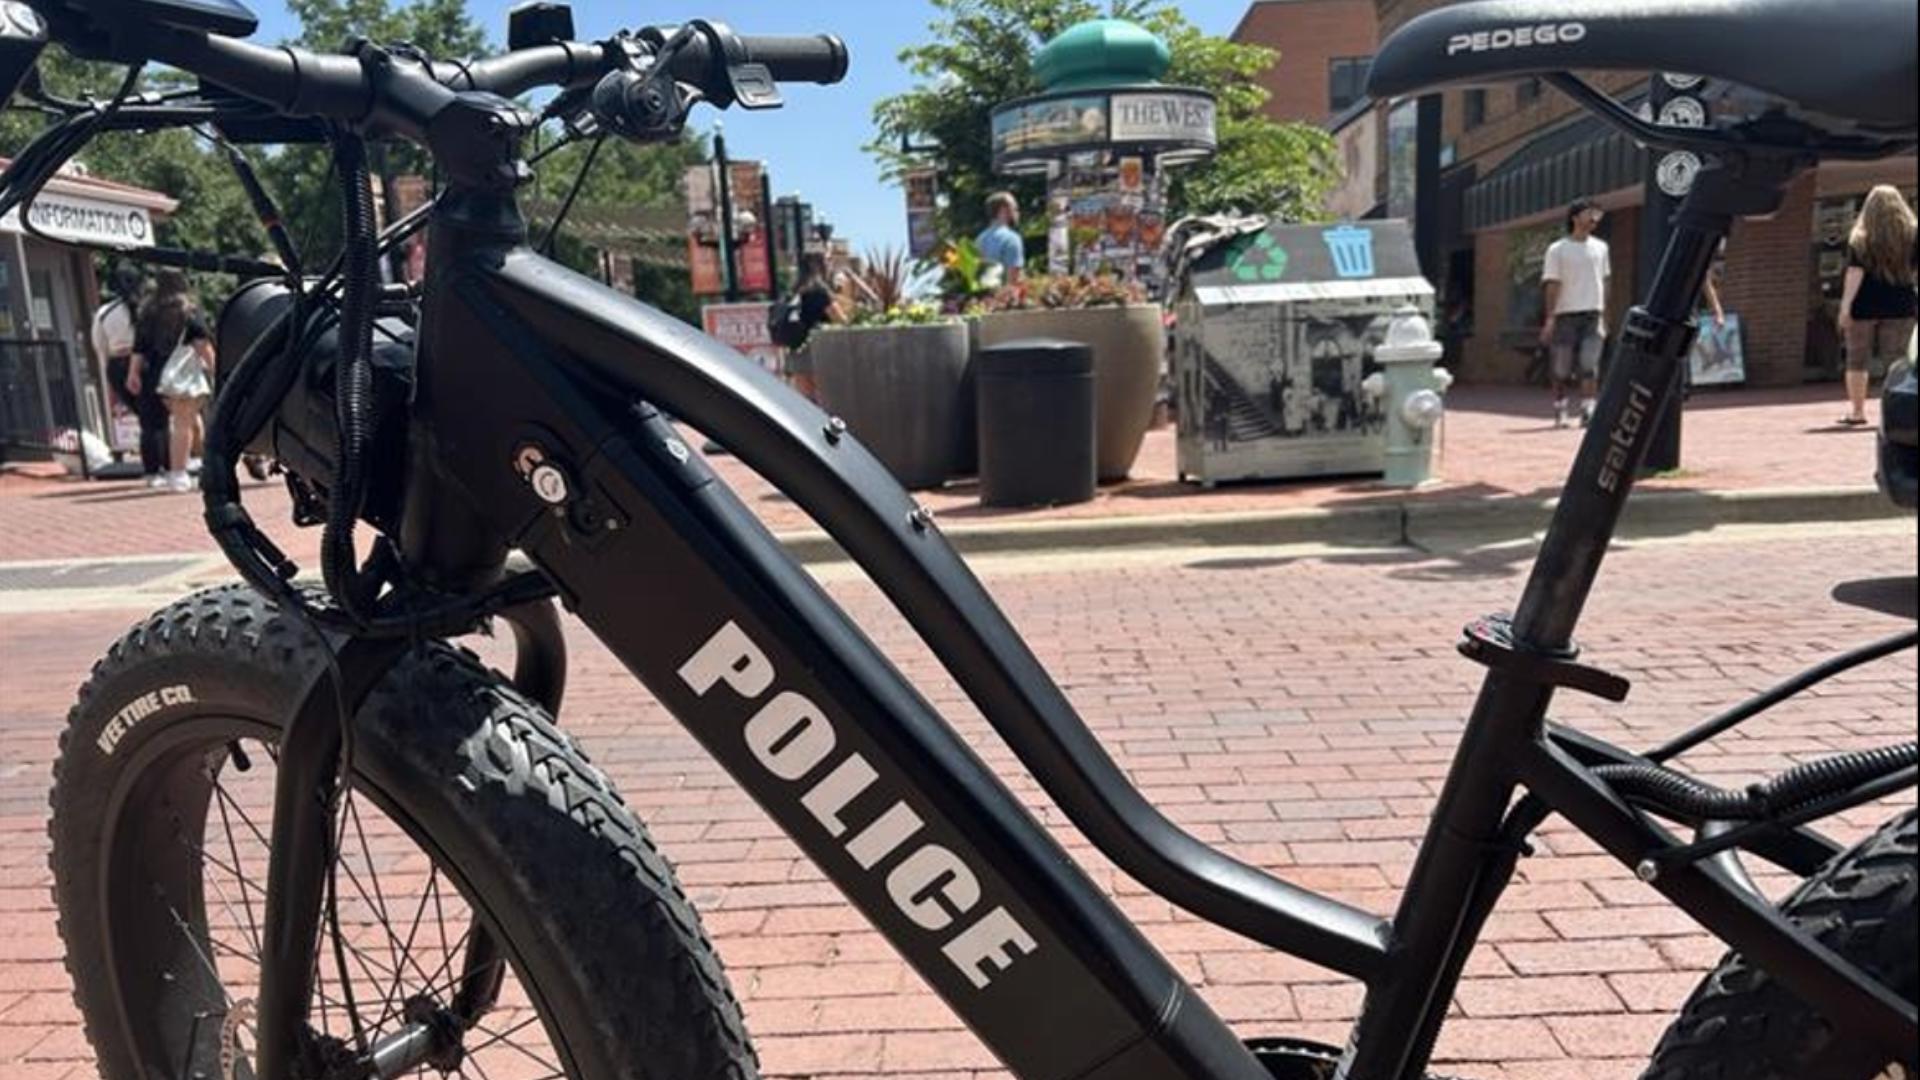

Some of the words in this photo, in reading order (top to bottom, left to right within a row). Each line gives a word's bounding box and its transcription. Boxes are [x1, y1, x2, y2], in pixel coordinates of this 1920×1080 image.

[1447, 22, 1587, 56] PEDEGO
[1119, 101, 1161, 125] THE
[30, 201, 127, 236] NFORMATION
[1598, 380, 1652, 492] satori
[96, 714, 127, 755] VEE
[119, 691, 163, 727] TIRE
[676, 619, 1039, 990] POLICE
